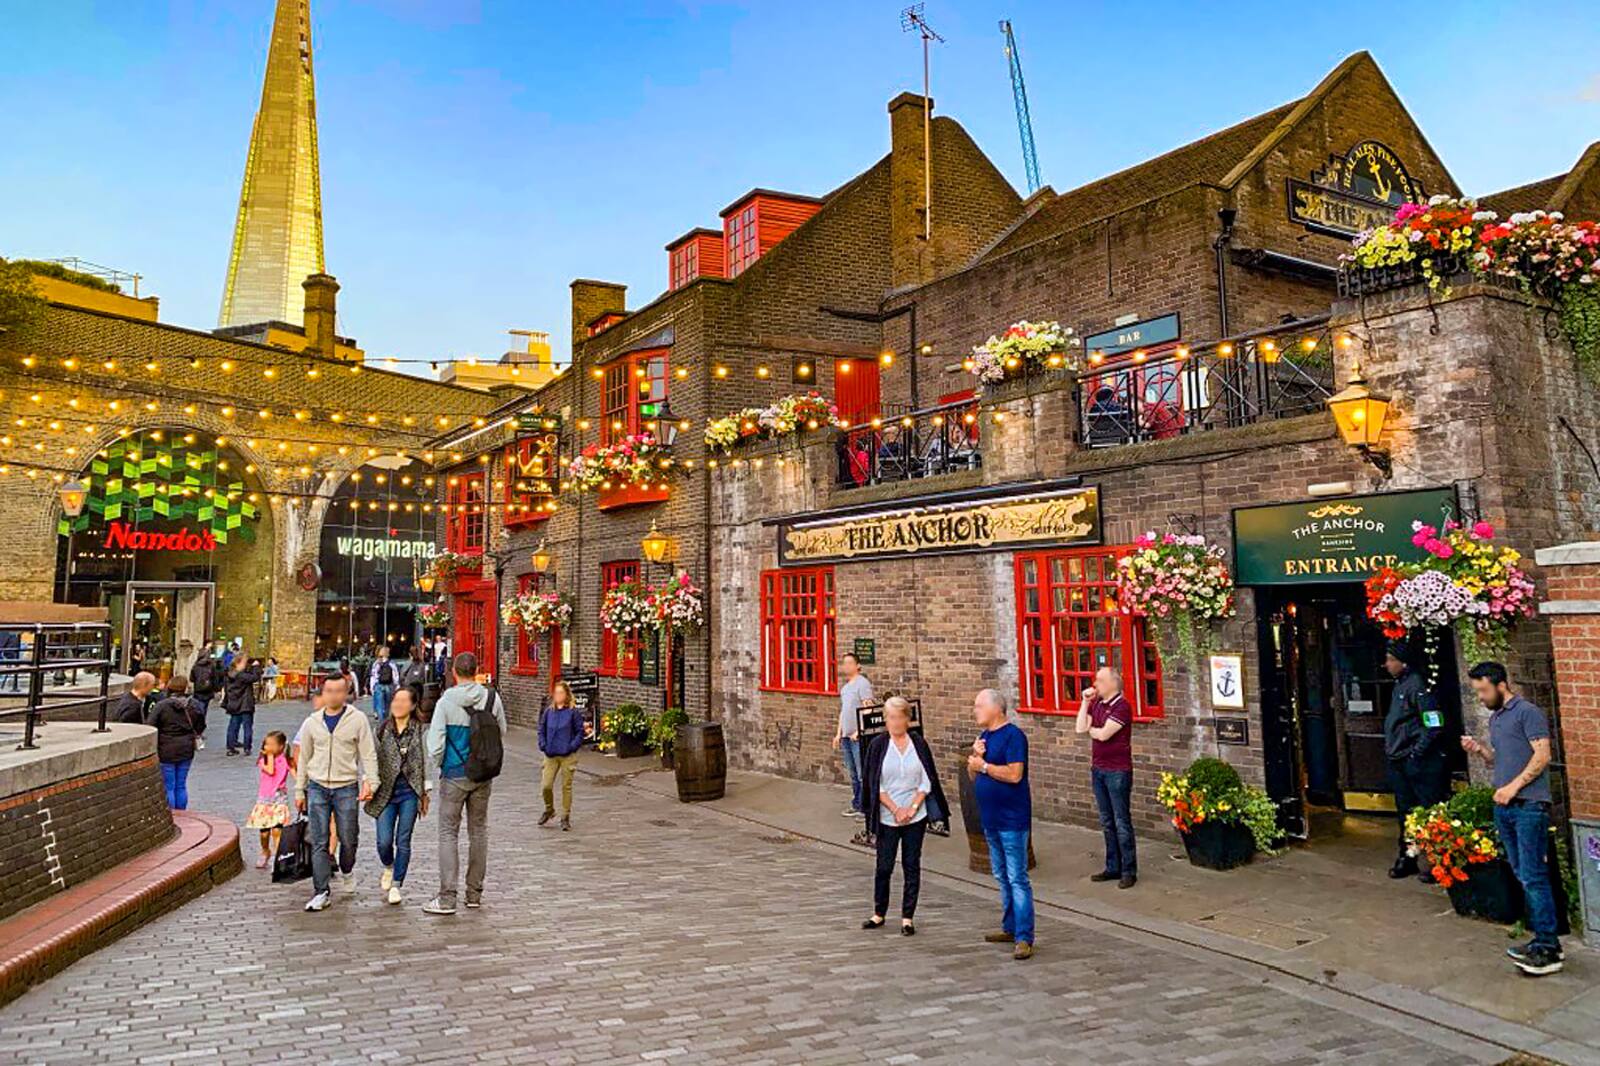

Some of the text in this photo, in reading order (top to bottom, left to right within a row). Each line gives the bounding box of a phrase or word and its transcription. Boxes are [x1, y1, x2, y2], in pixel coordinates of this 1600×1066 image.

[1119, 331, 1141, 344] BAR
[103, 522, 217, 551] Nando's
[845, 512, 992, 550] THE ANCHOR
[1292, 518, 1385, 540] THE ANCHOR
[337, 536, 436, 561] wagamama
[1285, 555, 1398, 575] ENTRANCE
